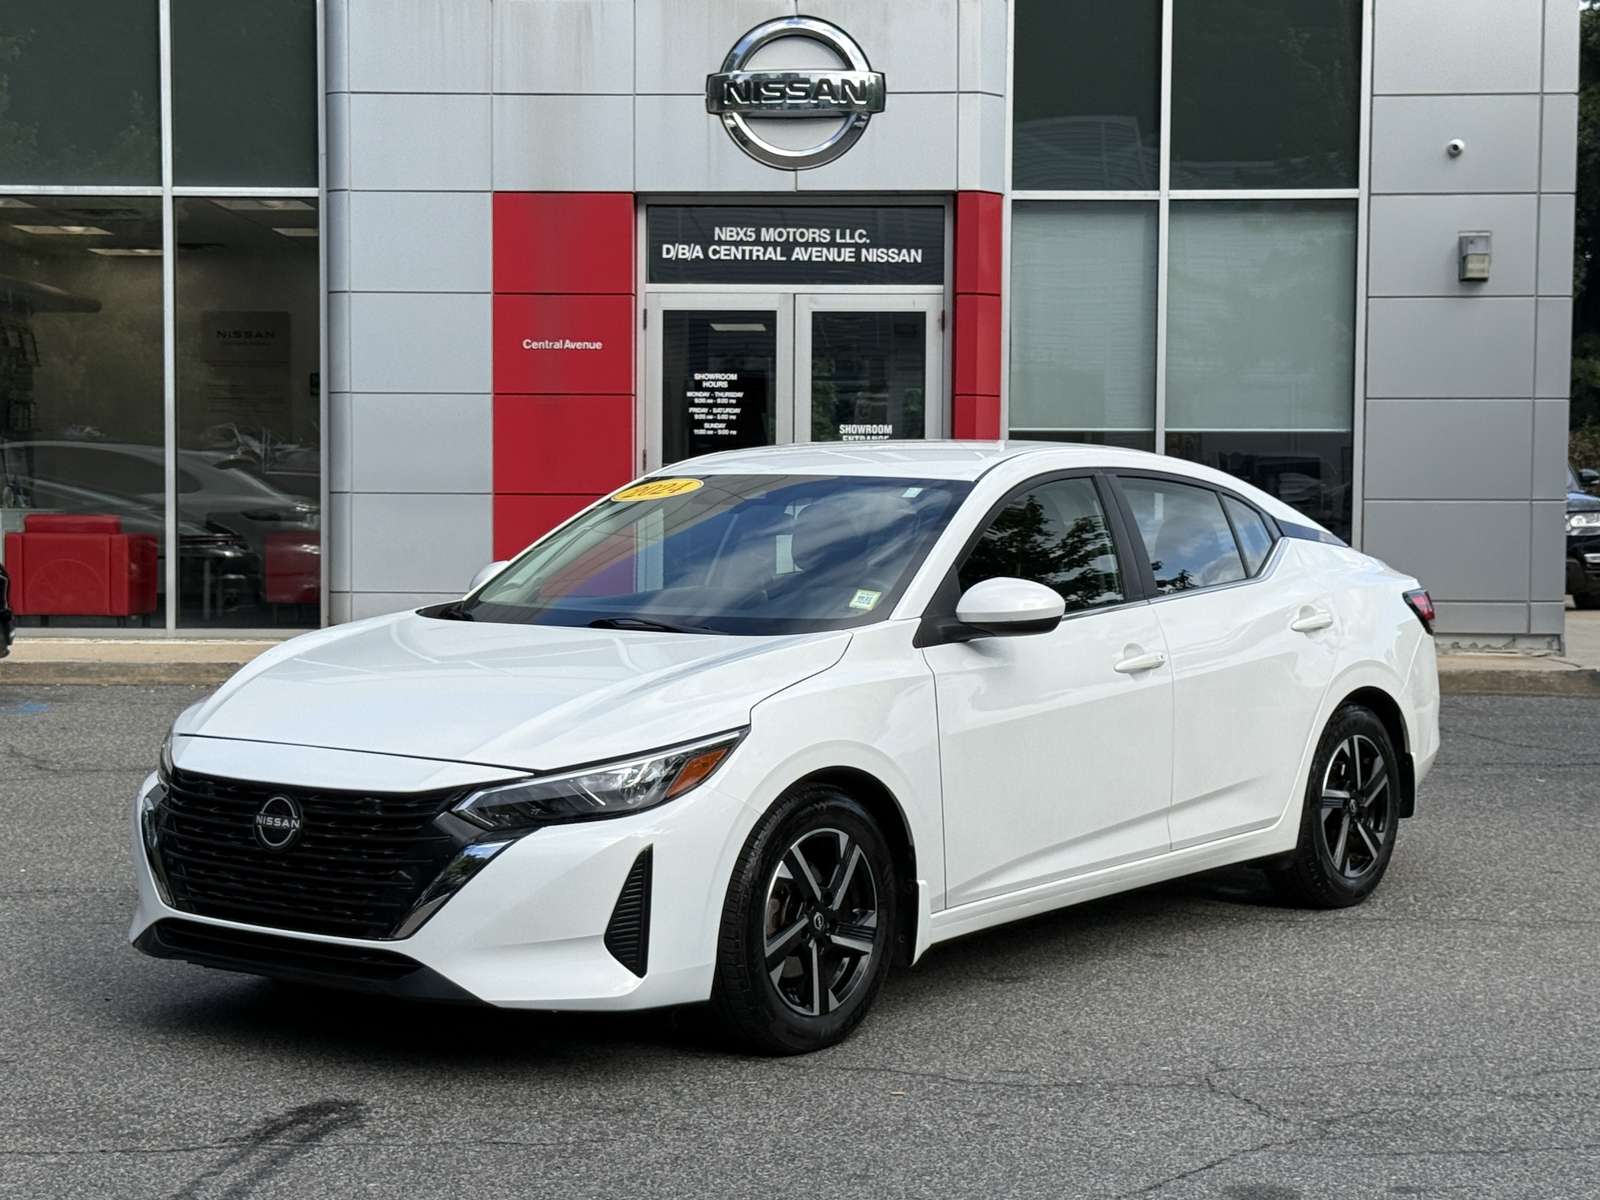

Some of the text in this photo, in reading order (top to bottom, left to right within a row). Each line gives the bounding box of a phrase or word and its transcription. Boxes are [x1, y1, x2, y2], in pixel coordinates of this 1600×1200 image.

[724, 78, 868, 104] NISSAN
[714, 226, 870, 244] NBX5 MOTORS LLC.
[662, 243, 922, 263] D/B/A CENTRAL AVENUE NISSAN
[217, 330, 276, 338] NISSAN
[522, 338, 602, 350] Central Avenue
[839, 424, 892, 434] SHOWROOM
[621, 482, 693, 498] 2024
[256, 815, 300, 828] NISSAN
